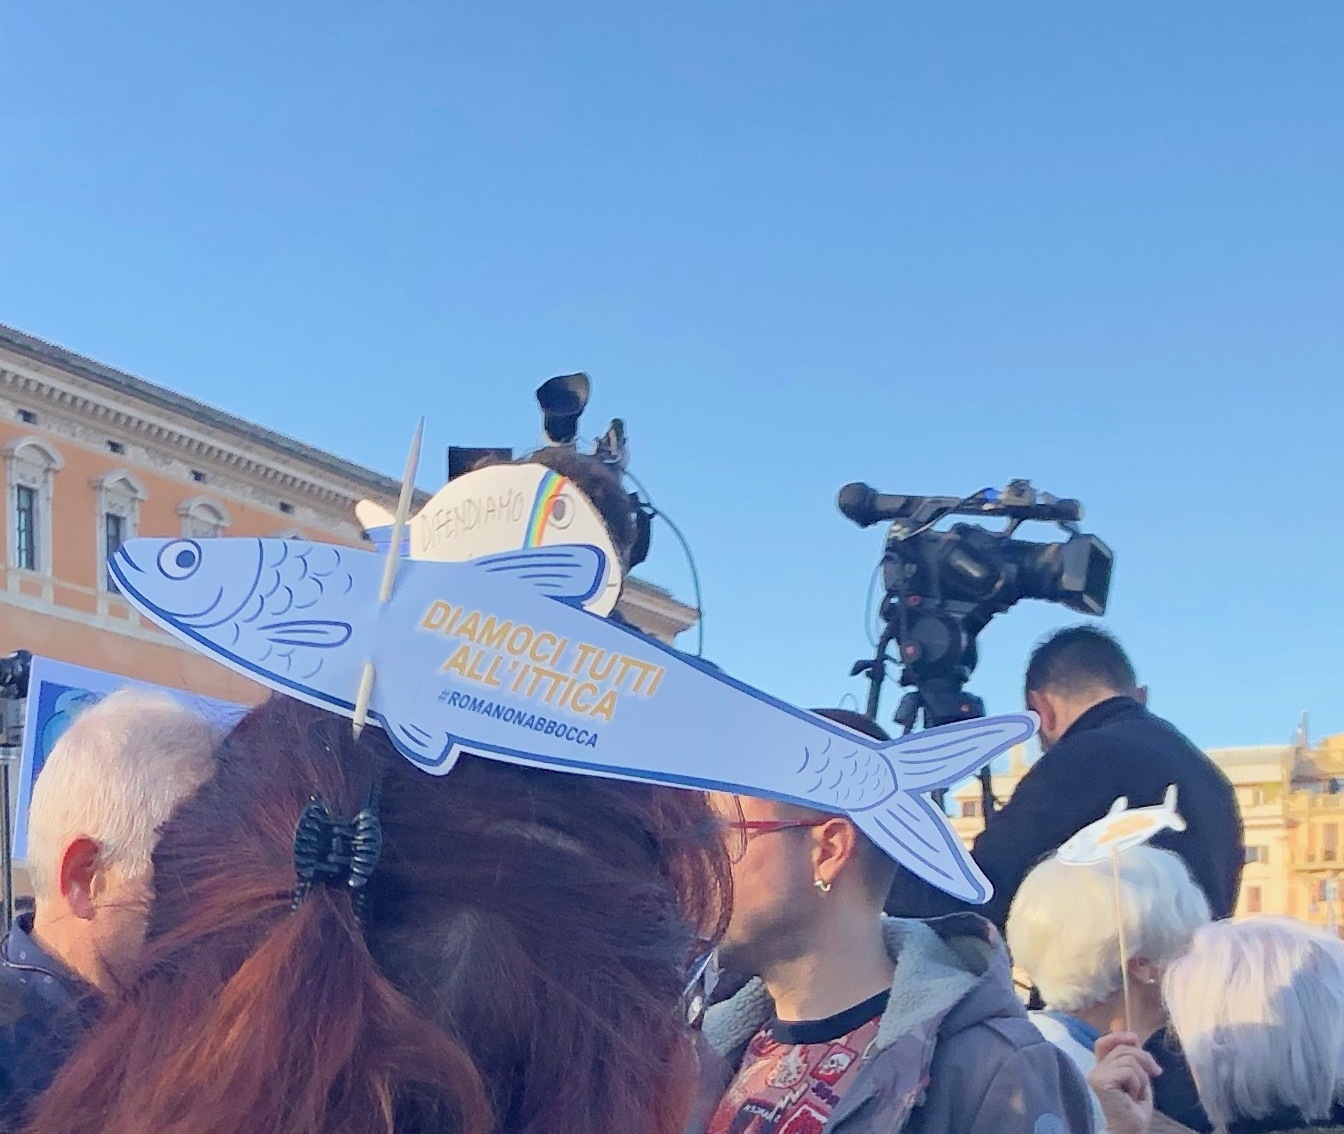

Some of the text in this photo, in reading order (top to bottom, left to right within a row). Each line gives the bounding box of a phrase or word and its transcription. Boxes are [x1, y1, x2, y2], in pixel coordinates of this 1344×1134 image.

[421, 600, 665, 698] DIAMOCI TUTTI
[443, 645, 619, 722] ALL'ITTICA
[437, 688, 599, 749] #ROMANONABBOCCA
